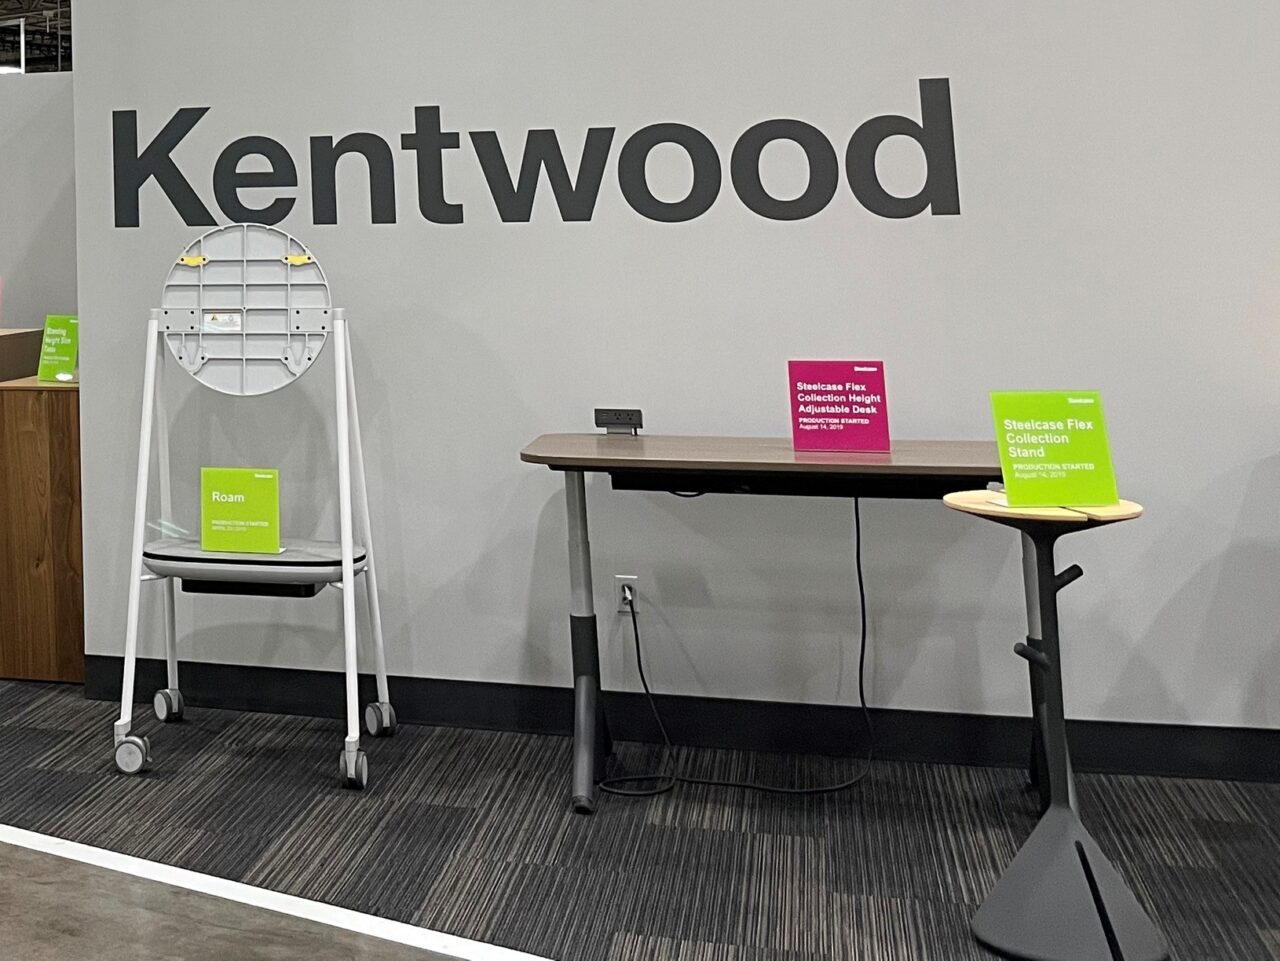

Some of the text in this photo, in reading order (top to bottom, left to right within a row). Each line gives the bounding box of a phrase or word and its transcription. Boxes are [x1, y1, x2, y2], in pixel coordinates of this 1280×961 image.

[112, 77, 961, 229] Kentwood
[797, 382, 866, 391] Steelcase Flex
[797, 393, 881, 404] Collection Height
[798, 405, 877, 415] Adjustable Desk
[1004, 419, 1093, 430] Steelcase Flex
[1006, 433, 1069, 443] Collection
[1008, 446, 1045, 457] Stand
[212, 491, 244, 502] Roam
